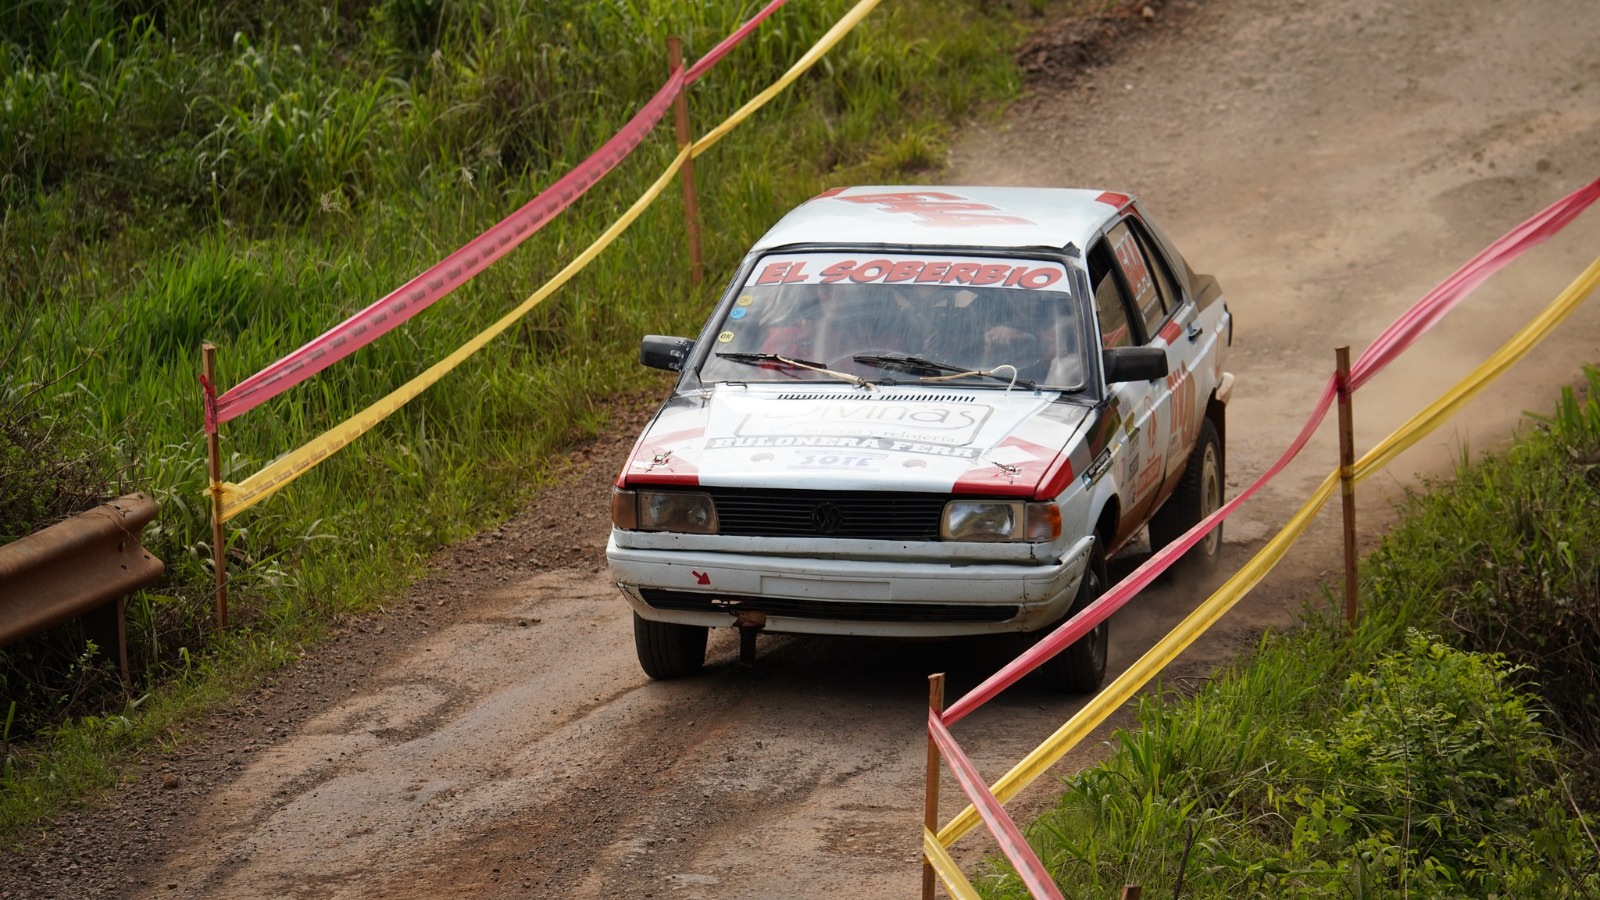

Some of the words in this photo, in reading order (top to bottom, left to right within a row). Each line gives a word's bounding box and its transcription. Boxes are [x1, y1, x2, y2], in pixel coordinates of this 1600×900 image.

[755, 261, 809, 285] EL
[820, 259, 1063, 289] SOBERBIO
[711, 437, 881, 449] BULONERA
